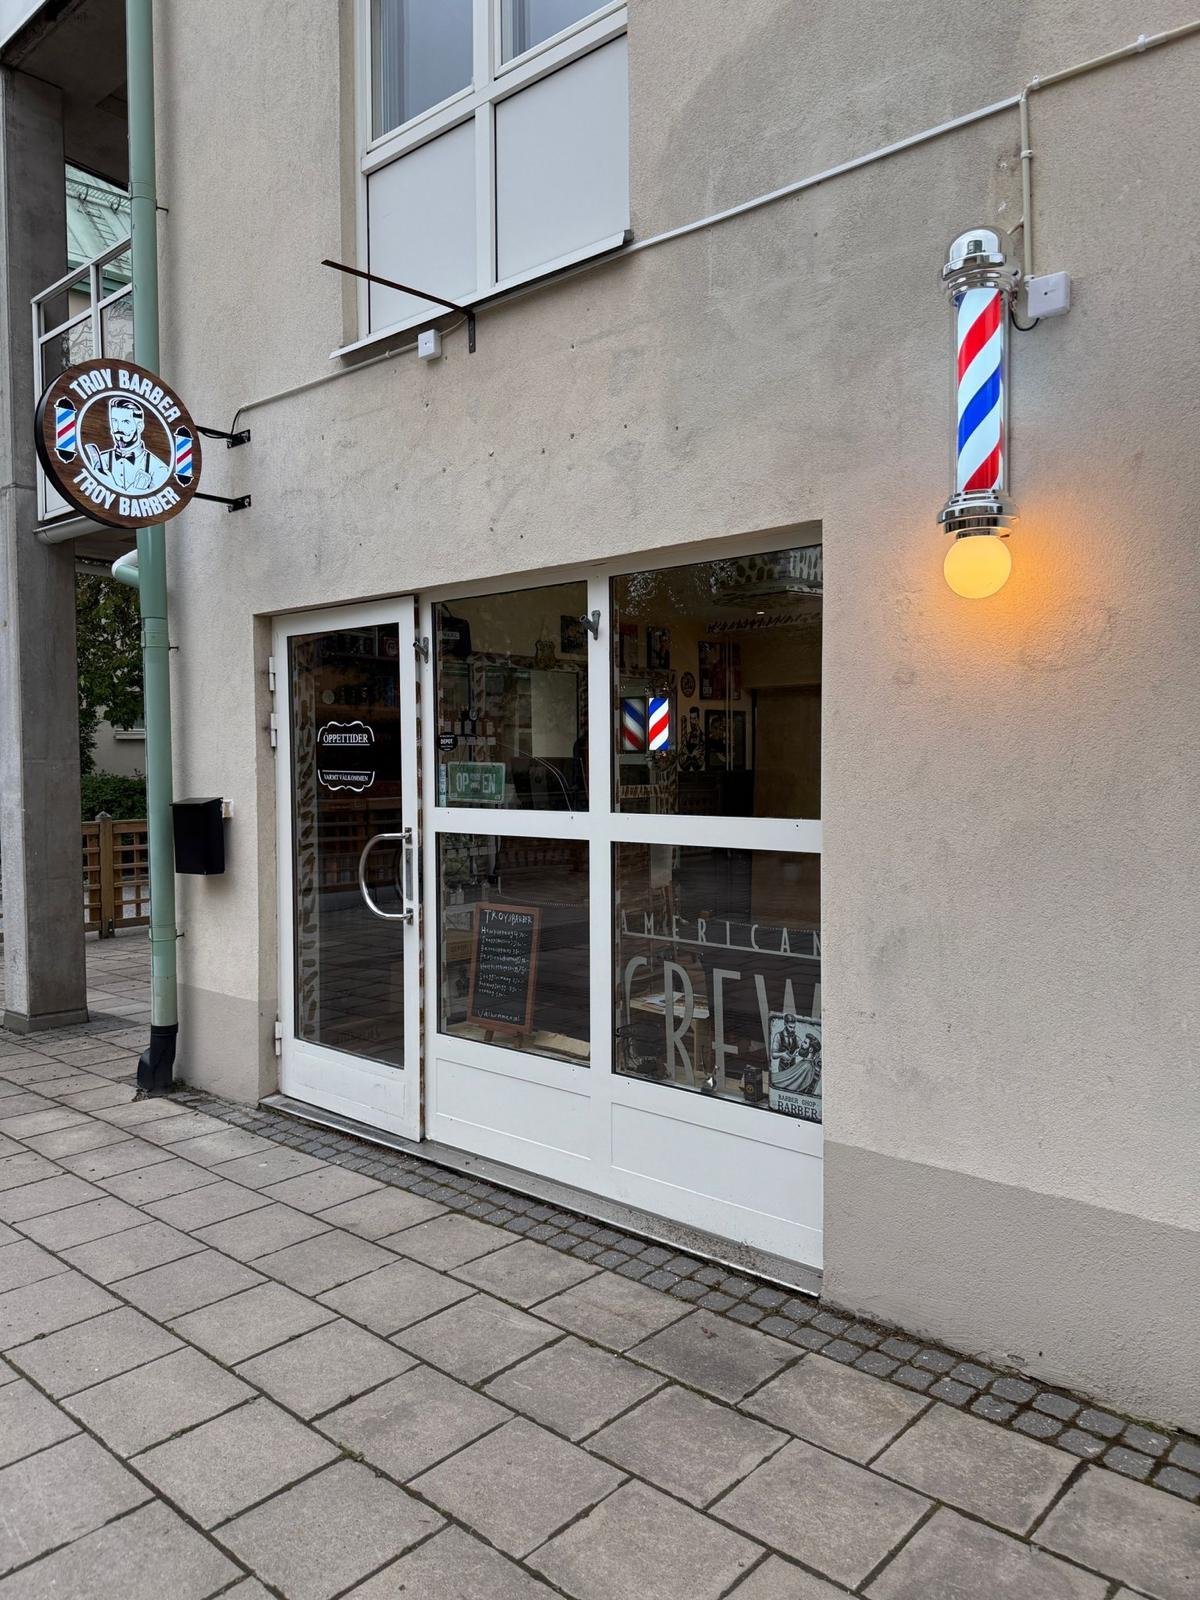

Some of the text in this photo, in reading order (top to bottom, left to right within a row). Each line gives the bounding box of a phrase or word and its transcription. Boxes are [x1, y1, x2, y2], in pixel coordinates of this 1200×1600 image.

[69, 369, 181, 423] TROY BARBER
[72, 468, 181, 518] TROY BARBER
[323, 732, 368, 743] ÖPPETTIDER
[777, 1100, 818, 1120] BARBER
